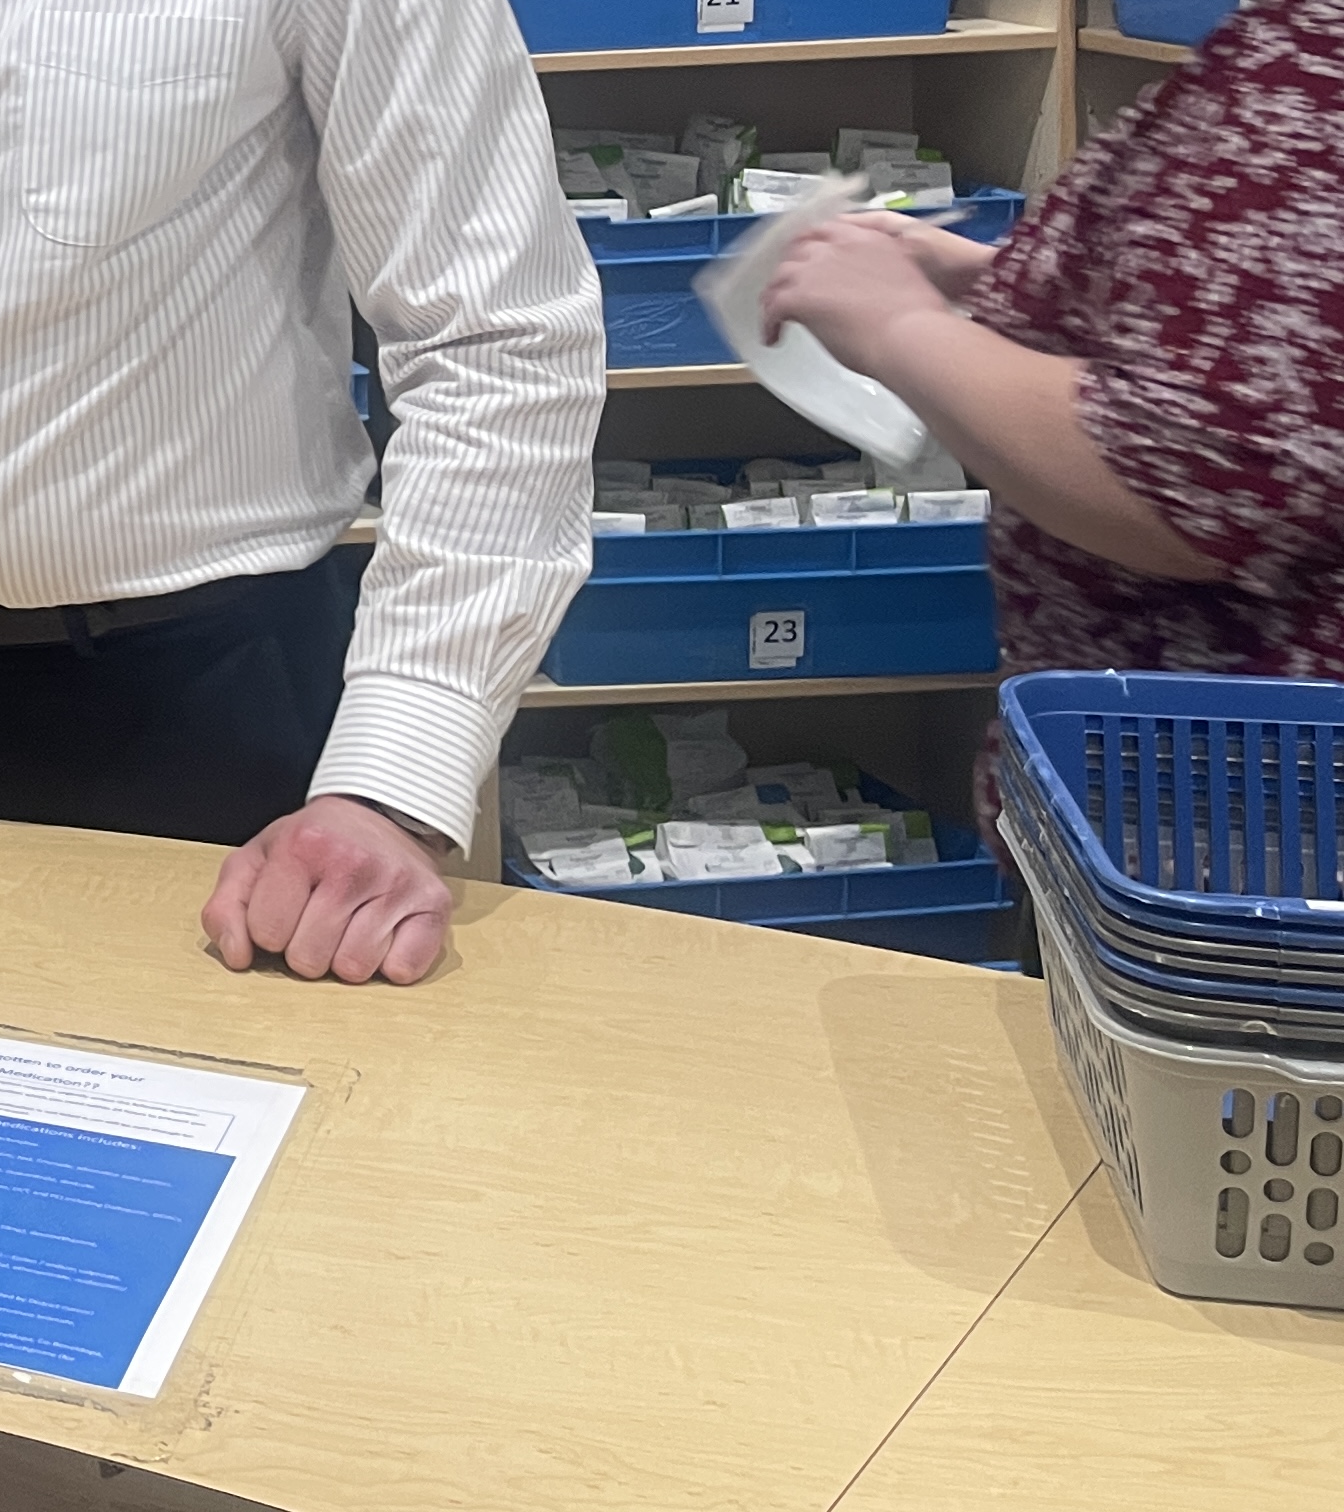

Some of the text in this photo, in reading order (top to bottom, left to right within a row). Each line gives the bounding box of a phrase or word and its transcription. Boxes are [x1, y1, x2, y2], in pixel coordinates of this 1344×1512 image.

[764, 619, 798, 644] 23
[46, 1061, 62, 1070] to
[65, 1063, 108, 1078] order
[110, 1072, 146, 1084] your
